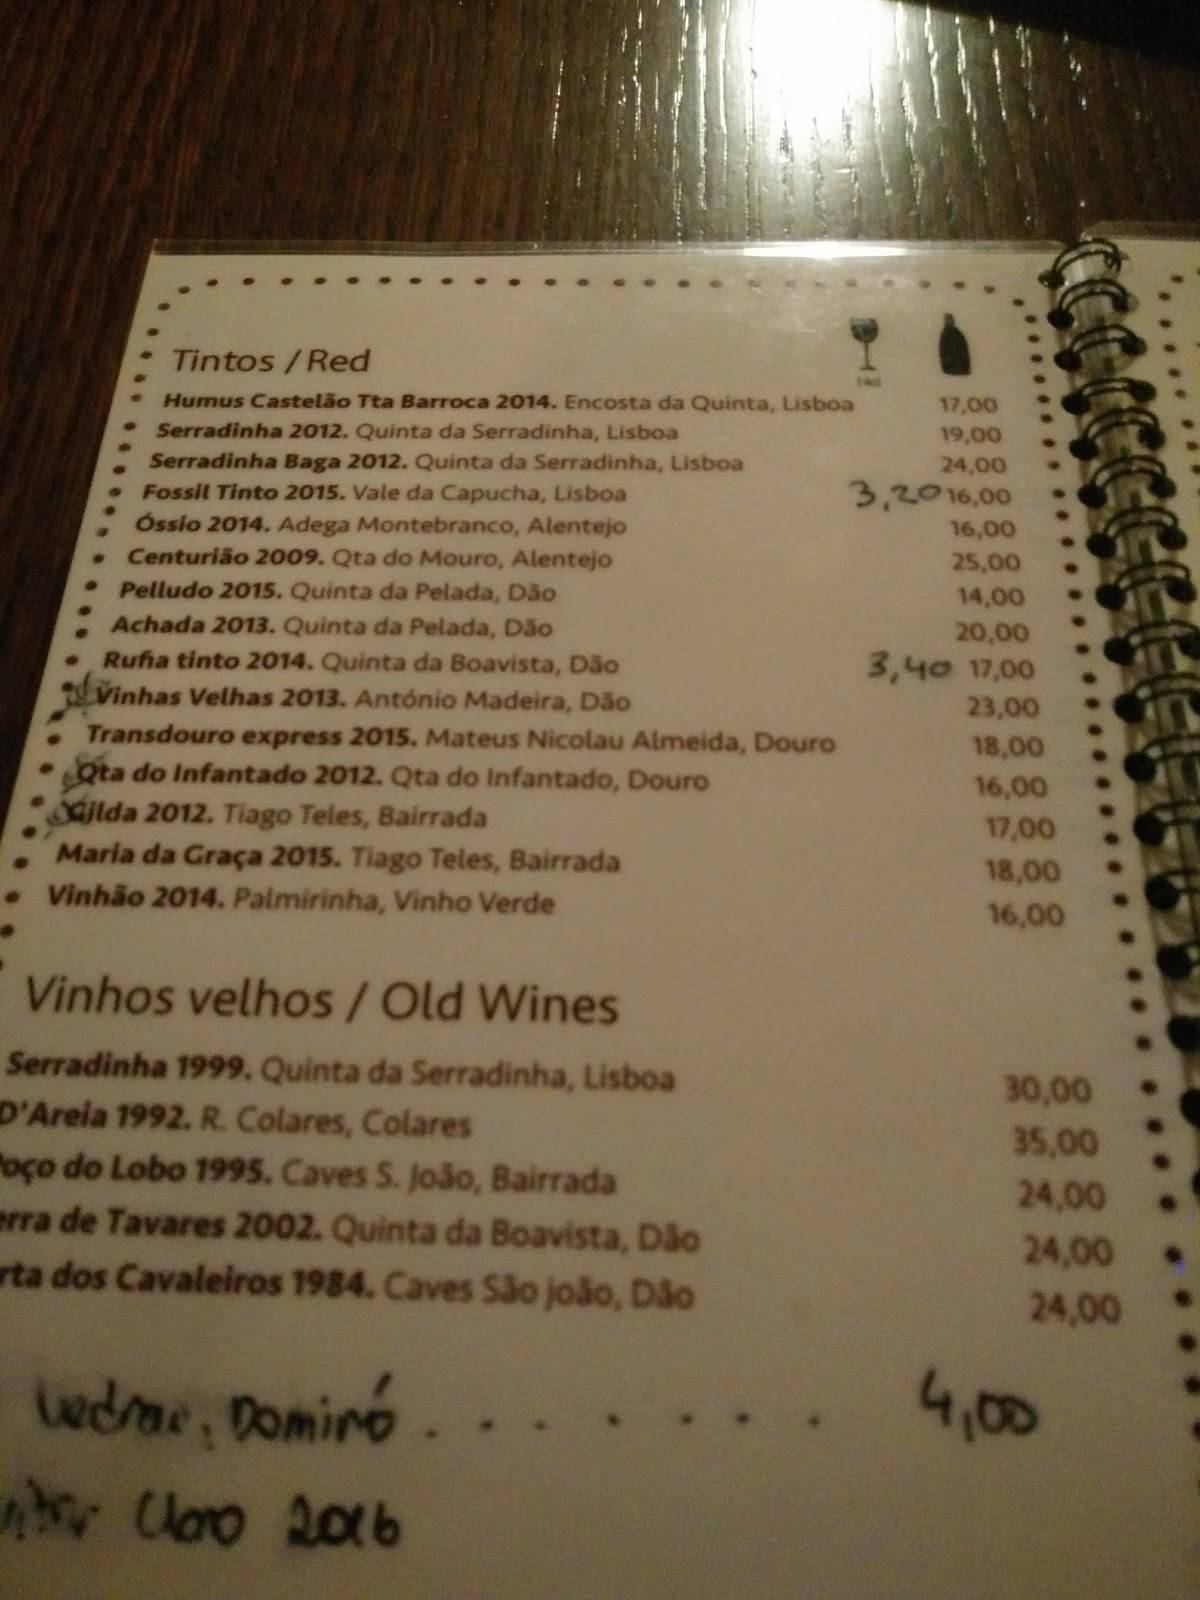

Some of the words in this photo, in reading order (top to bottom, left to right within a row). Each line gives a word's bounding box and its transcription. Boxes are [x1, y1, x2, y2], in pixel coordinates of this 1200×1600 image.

[173, 349, 275, 373] Tintos
[306, 348, 371, 373] Red
[162, 392, 245, 409] Humus
[249, 392, 352, 409] Castelão
[357, 393, 395, 410] Tta
[400, 393, 490, 410] Barroca
[495, 393, 558, 410] 2014.
[564, 394, 652, 411] Encosta
[658, 395, 685, 411] da
[691, 395, 775, 413] Quinta,
[783, 395, 854, 412] Lisboa
[940, 397, 998, 415] 17,00
[156, 422, 283, 439] Serradinha
[288, 423, 349, 439] 2012.
[355, 423, 433, 441] Quinta
[438, 423, 466, 439] da
[472, 423, 599, 442] Serradinha,
[607, 424, 679, 440] Lisboa
[941, 427, 1002, 445] 19,00
[149, 451, 278, 470] Serradinha
[283, 453, 342, 474] Baga
[346, 453, 408, 470] 2012.
[415, 453, 494, 472] Quinta
[499, 453, 527, 470] da
[534, 454, 663, 473] Serradinha,
[671, 454, 744, 472] Lisboa
[942, 456, 1007, 475] 24,00
[142, 482, 211, 501] Fossil
[216, 483, 279, 501] Tinto
[284, 484, 346, 501] 2015.
[353, 484, 401, 501] Vale
[406, 484, 434, 501] da
[440, 484, 546, 505] Capucha,
[554, 485, 627, 502] Lisboa
[849, 480, 942, 512] 3,20
[946, 487, 1012, 507] 16,00
[134, 511, 202, 533] Óssio
[206, 515, 271, 533] 2014.
[277, 515, 350, 538] Adega
[357, 516, 519, 537] Montebranco,
[527, 516, 627, 539] Alentejo
[950, 520, 1016, 540] 16,00
[127, 547, 250, 566] Centurião
[254, 548, 325, 566] 2009.
[332, 548, 377, 569] Qta
[383, 549, 413, 567] do
[419, 549, 504, 570] Mouro,
[511, 549, 613, 572] Alentejo
[953, 552, 1021, 574] 25,00
[119, 580, 215, 600] Pelludo
[218, 581, 283, 600] 2015.
[290, 581, 373, 602] Quinta
[379, 582, 408, 601] da
[415, 582, 500, 604] Pelada,
[508, 583, 556, 603] Dão
[958, 587, 1025, 609] 14,00
[110, 614, 206, 635] Achada
[210, 615, 276, 635] 2013.
[283, 616, 367, 638] Quinta
[373, 617, 403, 636] da
[409, 617, 496, 640] Pelada,
[504, 618, 553, 638] Dão
[956, 622, 1030, 645] 20,00
[176, 650, 241, 671] tinto
[245, 650, 314, 671] 2014.
[321, 652, 406, 674] Quinta
[413, 652, 443, 673] da
[450, 653, 561, 677] Boavista,
[569, 654, 619, 675] Dão
[868, 650, 953, 685] 3,40
[969, 659, 1035, 682] 17,00
[96, 686, 182, 707] Vinhas
[189, 686, 274, 708] Velhas
[279, 688, 347, 709] 2013.
[354, 688, 457, 710] António
[464, 690, 572, 714] Madeira,
[580, 691, 631, 712] Dão
[968, 696, 1040, 720] 23,00
[87, 723, 236, 746] Transdouro
[240, 729, 343, 751] express
[348, 726, 418, 748] 2015.
[425, 728, 520, 749] Mateus
[527, 729, 624, 751] Nicolau
[631, 730, 746, 755] Almeida,
[754, 731, 837, 754] Douro
[972, 735, 1044, 760] 18,00
[76, 762, 126, 786] Qta
[131, 761, 168, 784] do
[172, 761, 309, 786] Infantado
[312, 764, 383, 787] 2012.
[390, 765, 440, 790] Qta
[446, 766, 480, 788] do
[487, 766, 620, 793] Infantado,
[628, 769, 710, 792] Douro
[975, 775, 1048, 800] 16,00
[143, 801, 214, 825] 2012.
[224, 802, 293, 831] Tiago
[300, 804, 369, 830] Teles,
[378, 805, 488, 829] Bairrada
[986, 816, 1057, 842] 17,00
[55, 841, 137, 865] Maria
[141, 842, 177, 866] da
[182, 843, 264, 872] Graça
[269, 844, 342, 869] 2015.
[352, 846, 423, 876] Tiago
[429, 847, 500, 874] Teles,
[509, 848, 621, 873] Bairrada
[985, 858, 1061, 885] 18,00
[48, 882, 146, 909] Vinhão
[150, 885, 225, 910] 2014.
[233, 886, 386, 915] Palmirinha,
[394, 890, 473, 914] Vinho
[478, 891, 556, 916] Verde
[988, 903, 1066, 929] 16,00
[26, 974, 175, 1017] Vinhos
[189, 977, 334, 1020] velhos
[381, 980, 464, 1023] Old
[478, 983, 619, 1026] Wines
[5, 1049, 169, 1080] Serradinha
[176, 1054, 252, 1082] 1999.
[260, 1055, 361, 1086] Quinta
[367, 1058, 403, 1086] da
[411, 1059, 575, 1093] Serradinha,
[583, 1063, 676, 1093] Lisboa
[1005, 1074, 1092, 1107] 30,00
[116, 1102, 192, 1132] 1992.
[236, 1105, 352, 1139] Colares,
[362, 1108, 472, 1139] Colares
[1014, 1126, 1099, 1159] 35,00
[61, 1151, 105, 1182] do
[109, 1153, 188, 1184] Lobo
[194, 1156, 273, 1186] 1995.
[281, 1158, 368, 1189] Caves
[491, 1163, 617, 1196] Bairrada
[1018, 1179, 1106, 1213] 24,00
[57, 1204, 99, 1236] de
[107, 1206, 227, 1239] Tavares
[232, 1210, 323, 1242] 2002.
[331, 1213, 438, 1247] Quinta
[490, 1217, 629, 1255] Boavista,
[638, 1222, 701, 1254] Dão
[1024, 1233, 1114, 1269] 24,00
[49, 1259, 109, 1293] dos
[114, 1262, 284, 1297] Cavaleiros
[291, 1267, 376, 1300] 1984.
[383, 1270, 474, 1304] Caves
[630, 1277, 695, 1311] Dão
[1031, 1290, 1122, 1328] 24,00
[918, 1367, 1040, 1443] 4,00
